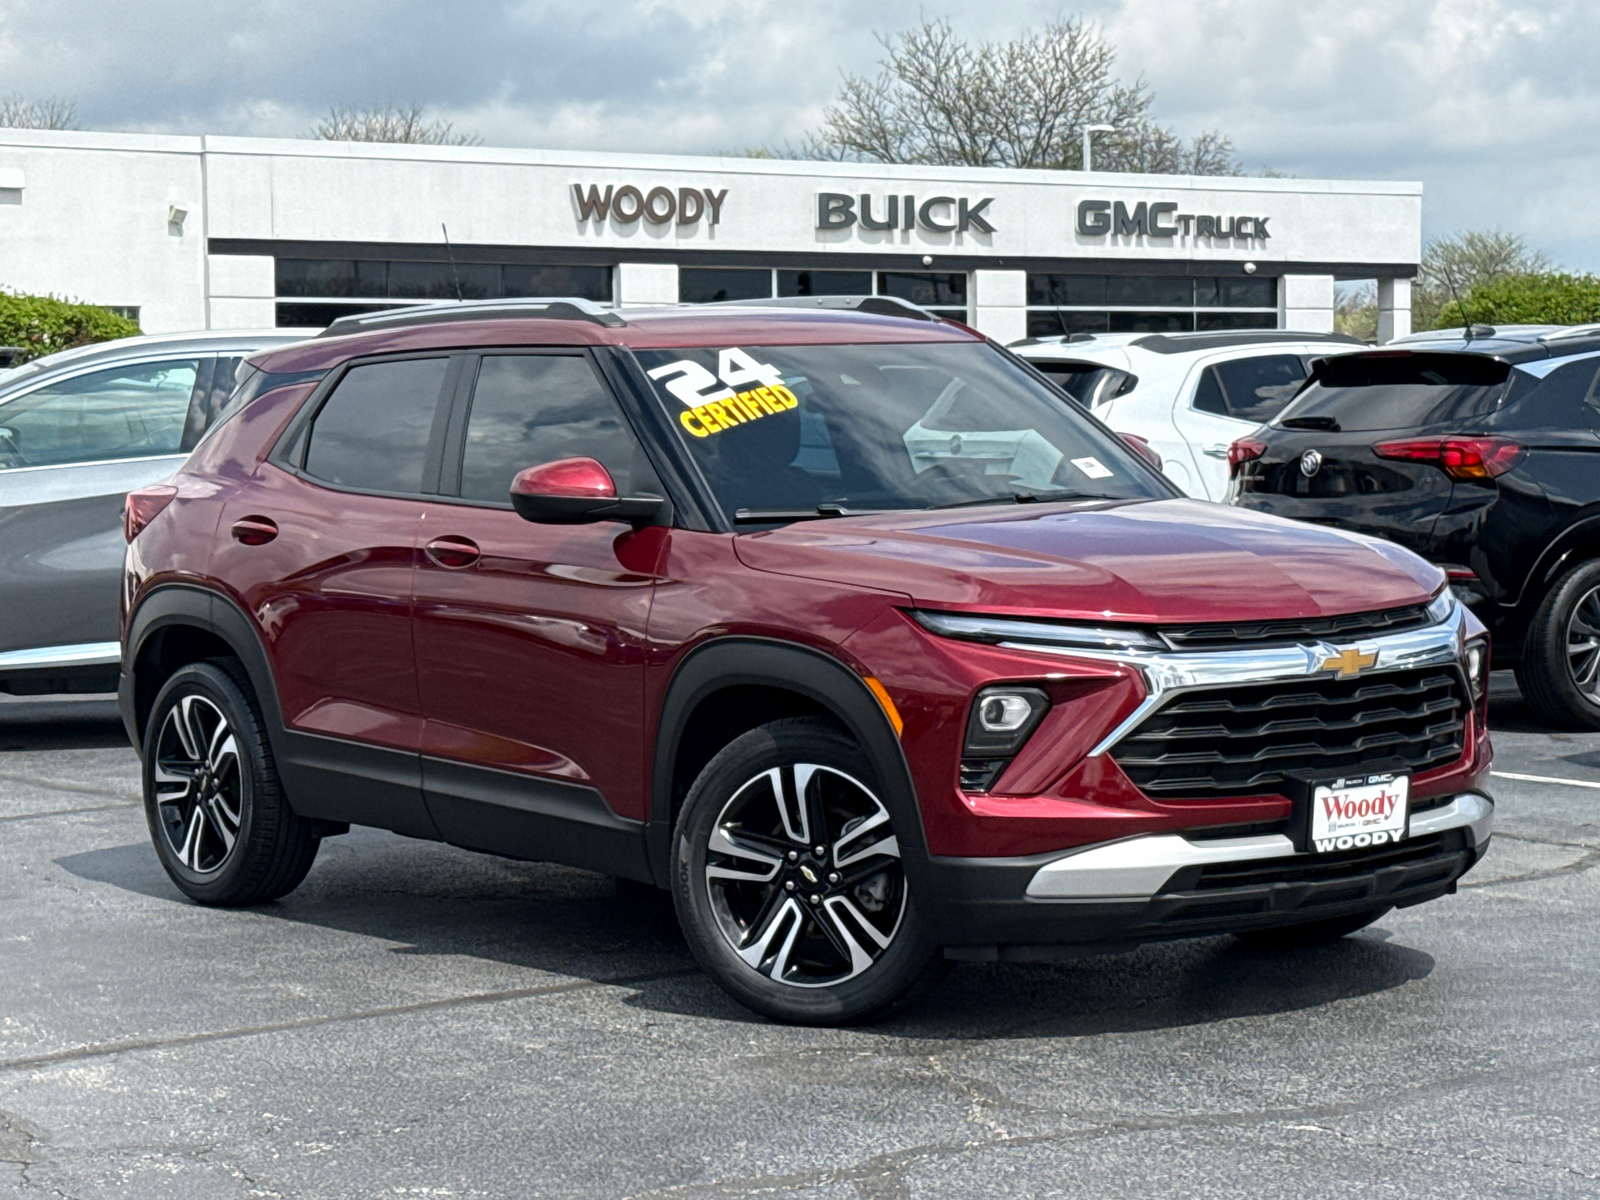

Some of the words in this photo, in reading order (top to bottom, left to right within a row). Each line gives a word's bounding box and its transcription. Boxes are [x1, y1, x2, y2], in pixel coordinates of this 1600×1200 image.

[571, 183, 729, 225] WOODY
[815, 192, 997, 233] BUICK
[1077, 200, 1178, 237] GMC
[1177, 214, 1271, 239] TRUCK
[647, 347, 785, 409] 24
[680, 384, 798, 438] CERTIFIED
[1321, 790, 1400, 821] Woody
[1315, 829, 1405, 853] WOODY
